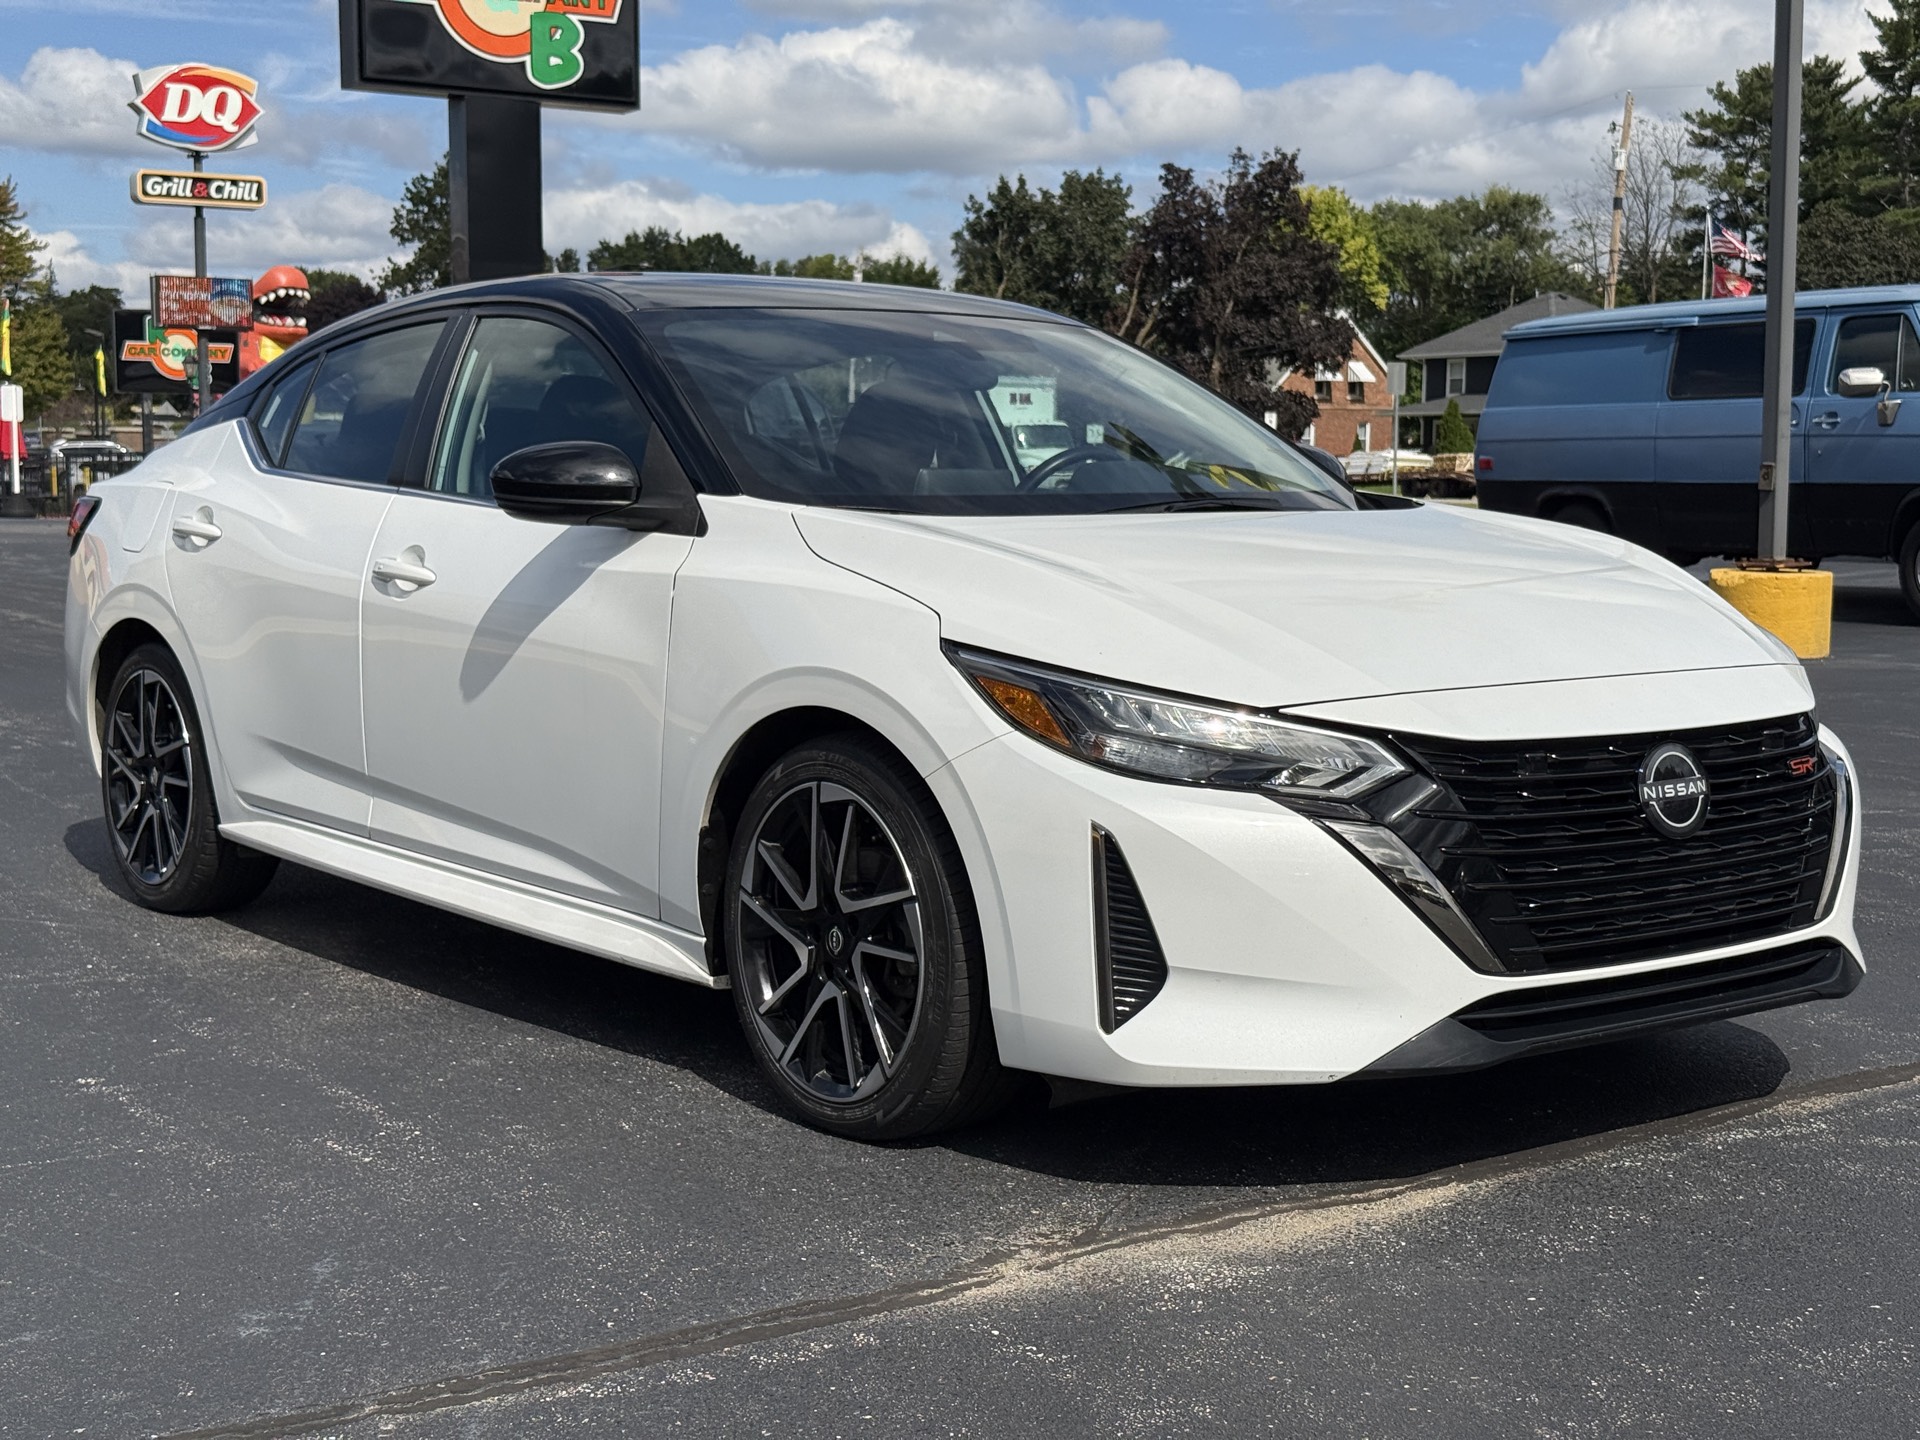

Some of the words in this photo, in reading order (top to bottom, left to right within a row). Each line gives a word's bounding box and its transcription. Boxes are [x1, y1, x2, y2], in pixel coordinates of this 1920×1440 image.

[161, 82, 243, 133] DQ
[128, 346, 157, 357] CAR
[1789, 755, 1816, 777] SR
[1643, 779, 1706, 799] NISSAN
